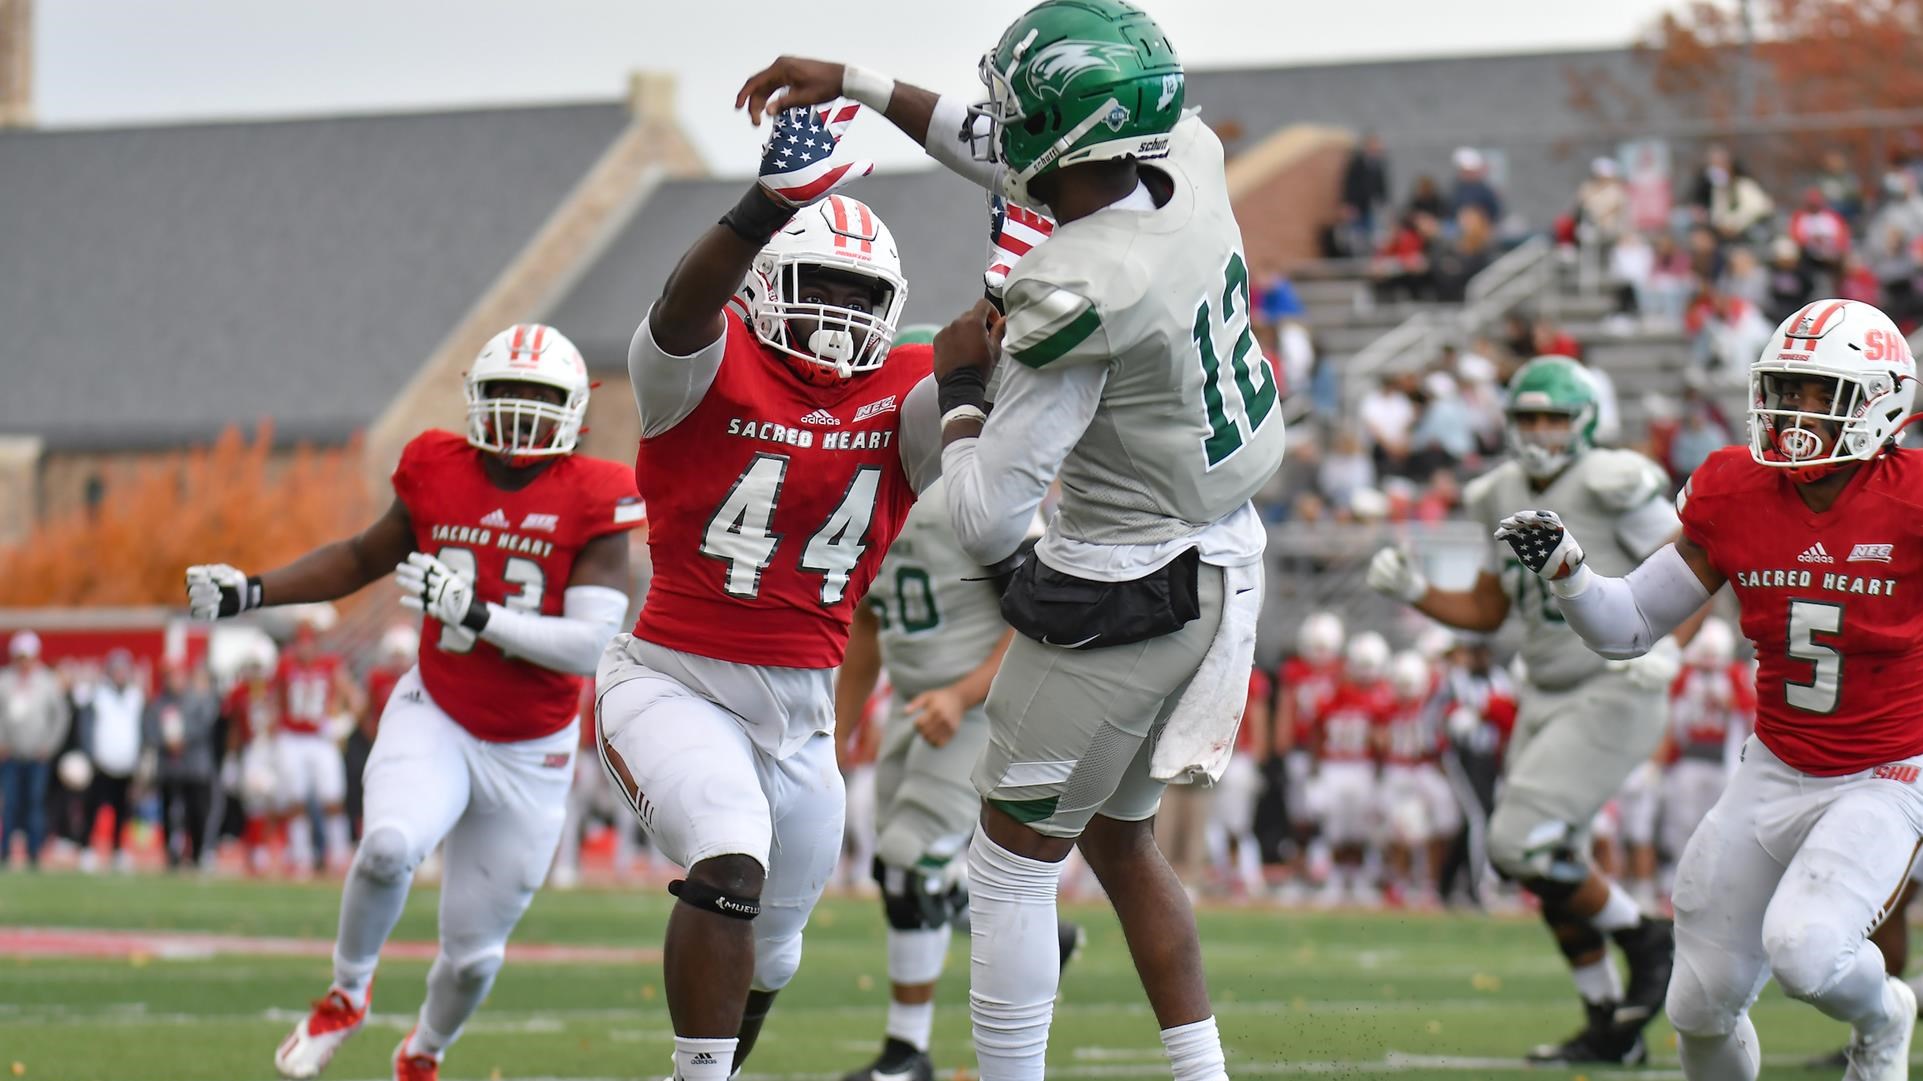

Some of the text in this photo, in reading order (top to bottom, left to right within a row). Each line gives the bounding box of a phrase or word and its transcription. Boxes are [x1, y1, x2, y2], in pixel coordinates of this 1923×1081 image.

[1193, 248, 1278, 471] 12
[727, 418, 893, 450] SACRED HEART
[800, 415, 841, 426] adidas
[432, 524, 554, 558] SACRED HEART
[700, 451, 883, 608] 44
[1797, 554, 1834, 564] adidas
[1849, 544, 1893, 560] NEC
[1737, 570, 1896, 596] SACRED HEART
[1785, 598, 1843, 714] 5
